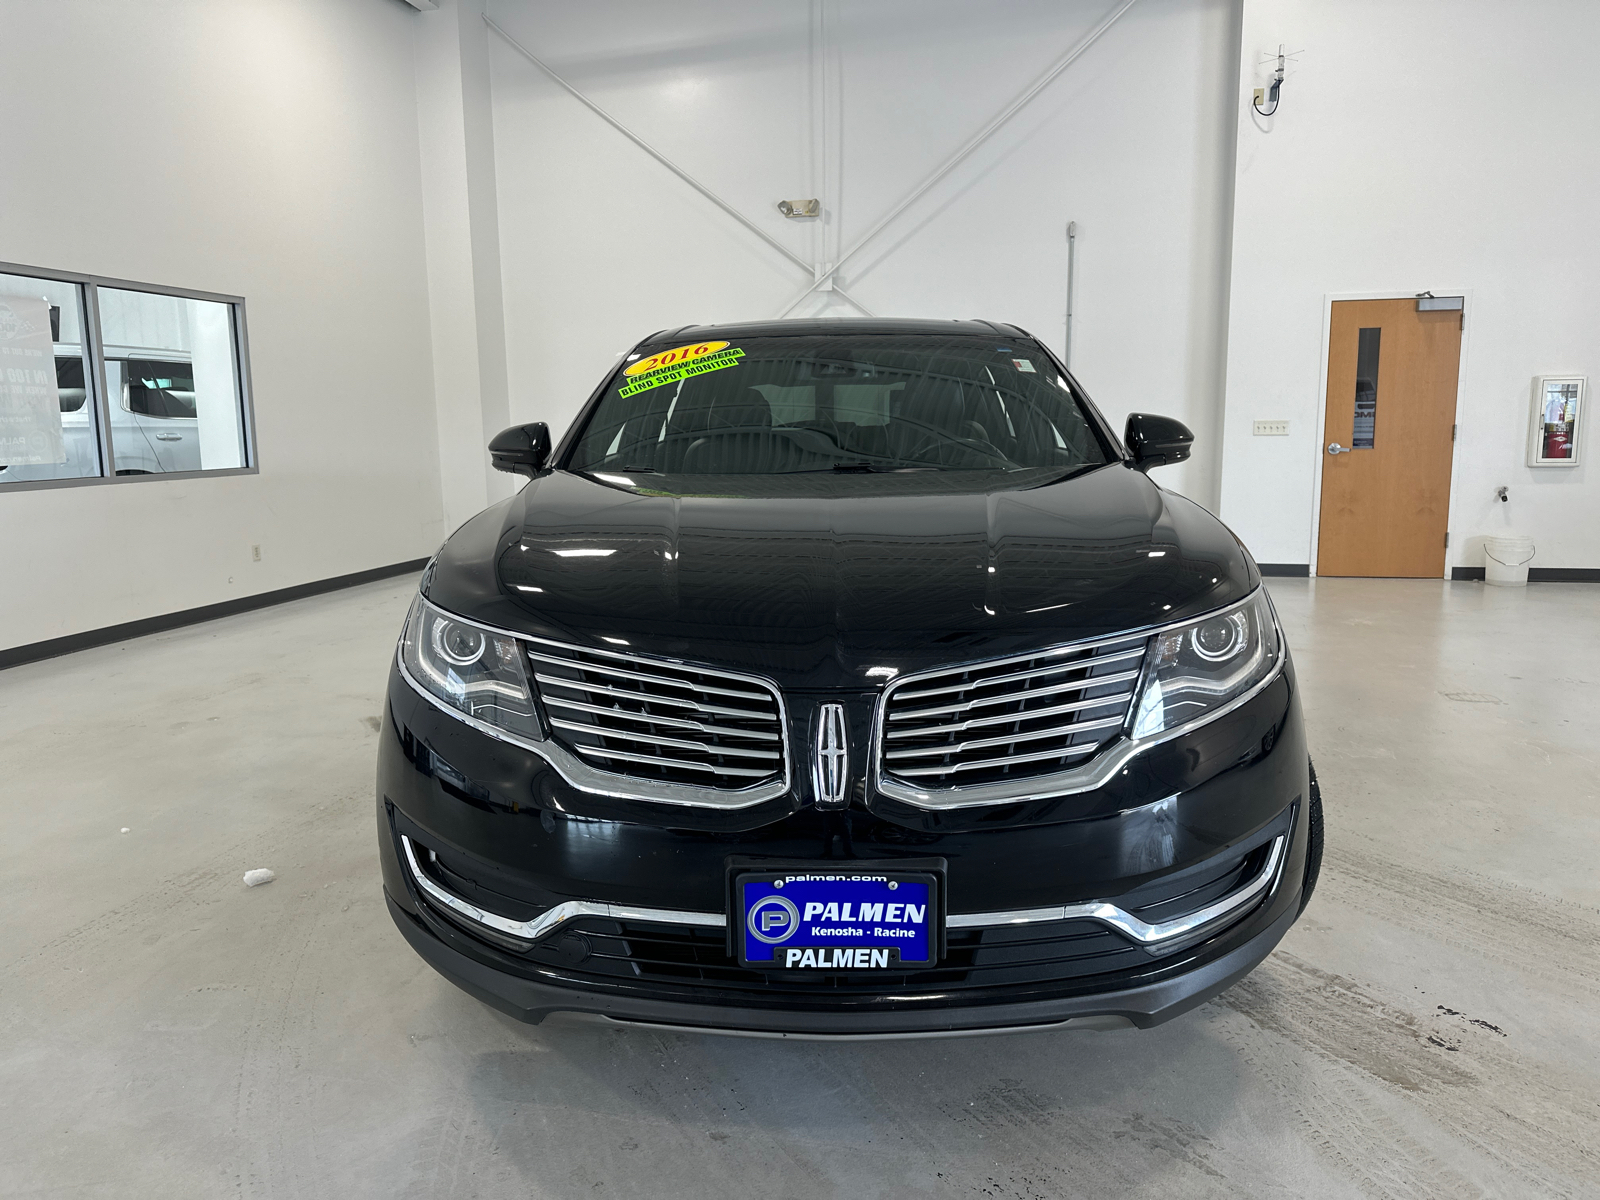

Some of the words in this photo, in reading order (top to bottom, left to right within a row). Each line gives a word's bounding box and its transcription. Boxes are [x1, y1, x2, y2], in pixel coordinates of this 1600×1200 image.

[630, 360, 691, 384] REARVIEW
[691, 349, 741, 365] CAMERA
[644, 342, 709, 372] 2016
[621, 380, 654, 396] BLIND
[656, 371, 683, 384] SPOT
[685, 357, 737, 376] MONITOR
[785, 874, 887, 883] palmen.com
[761, 911, 790, 932] P
[803, 902, 926, 923] PALMEN
[811, 927, 863, 937] Kenosha
[874, 928, 916, 938] Racine
[785, 949, 889, 968] PALMEN
